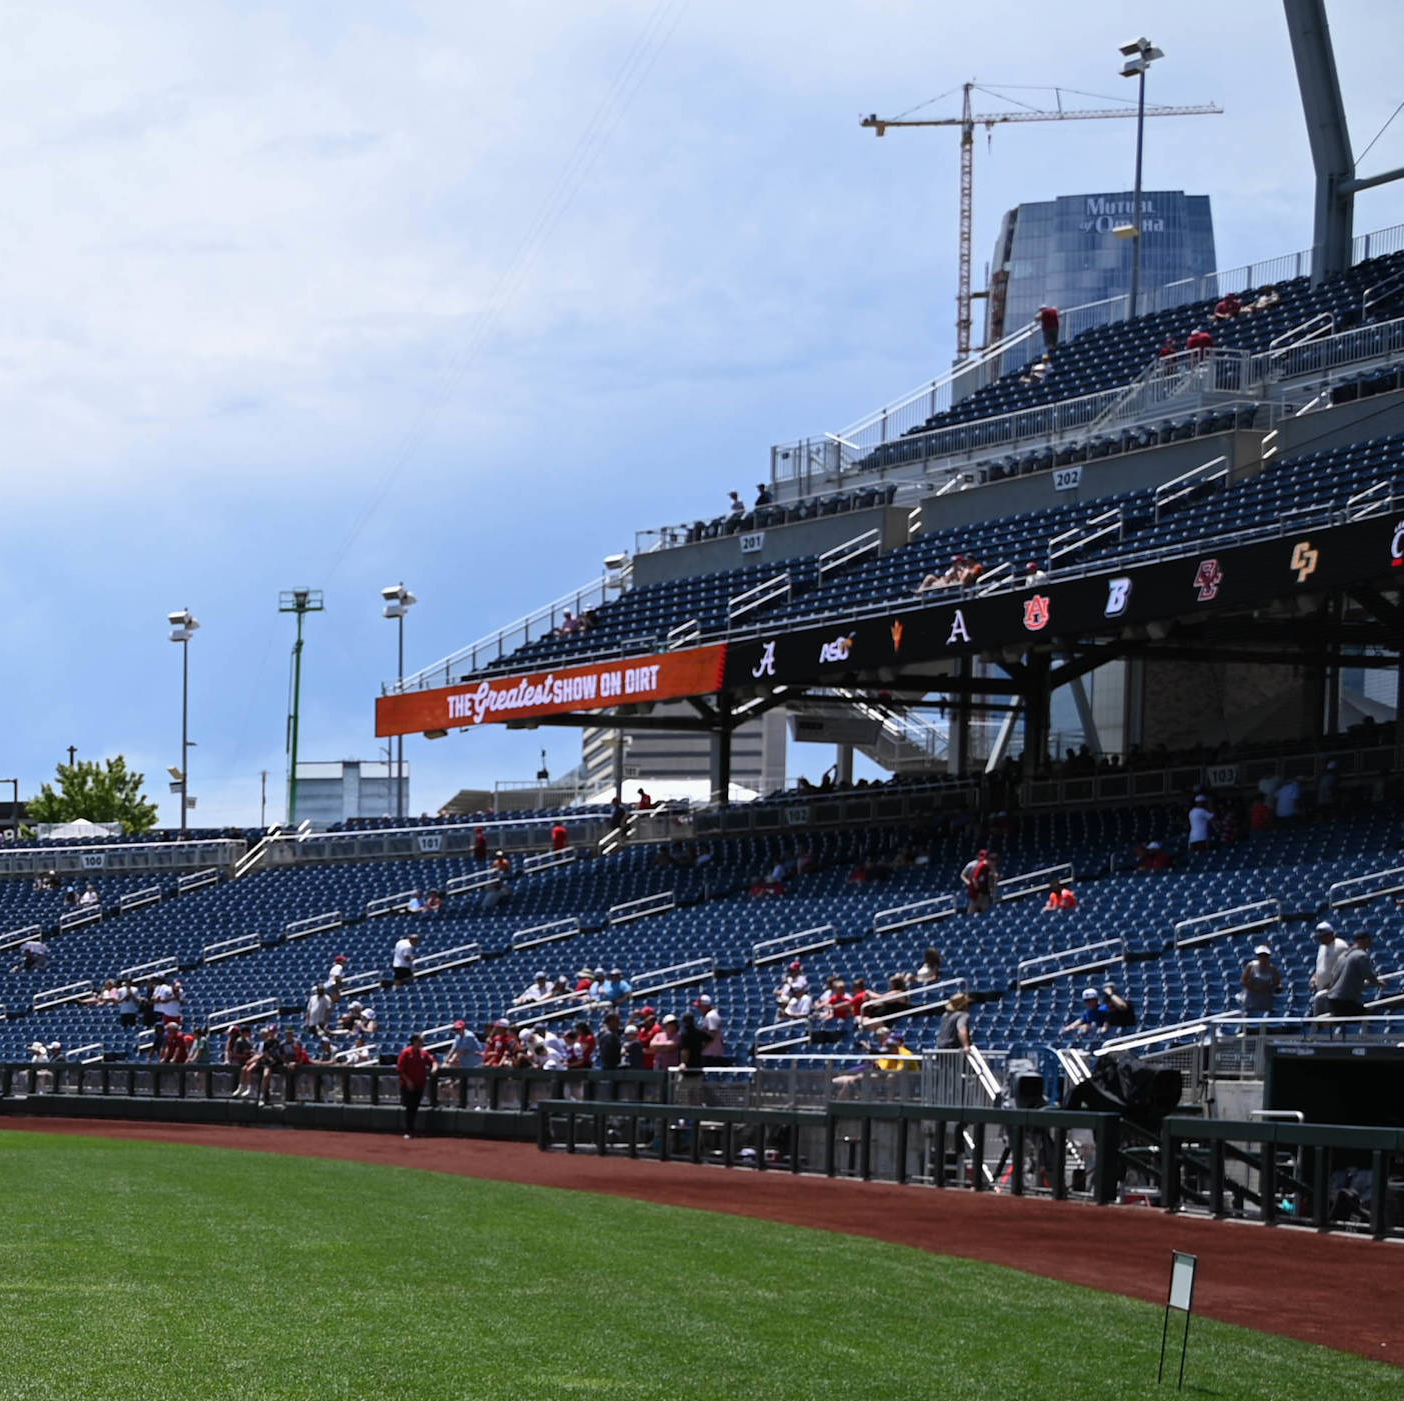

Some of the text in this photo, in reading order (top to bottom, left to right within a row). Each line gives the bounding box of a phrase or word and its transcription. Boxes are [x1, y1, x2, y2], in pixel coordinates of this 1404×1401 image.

[743, 536, 761, 549] 201
[946, 609, 972, 645] A
[753, 641, 776, 677] A
[447, 665, 661, 724] THE Greatest SHOW ON DIRT
[85, 856, 102, 866] 100
